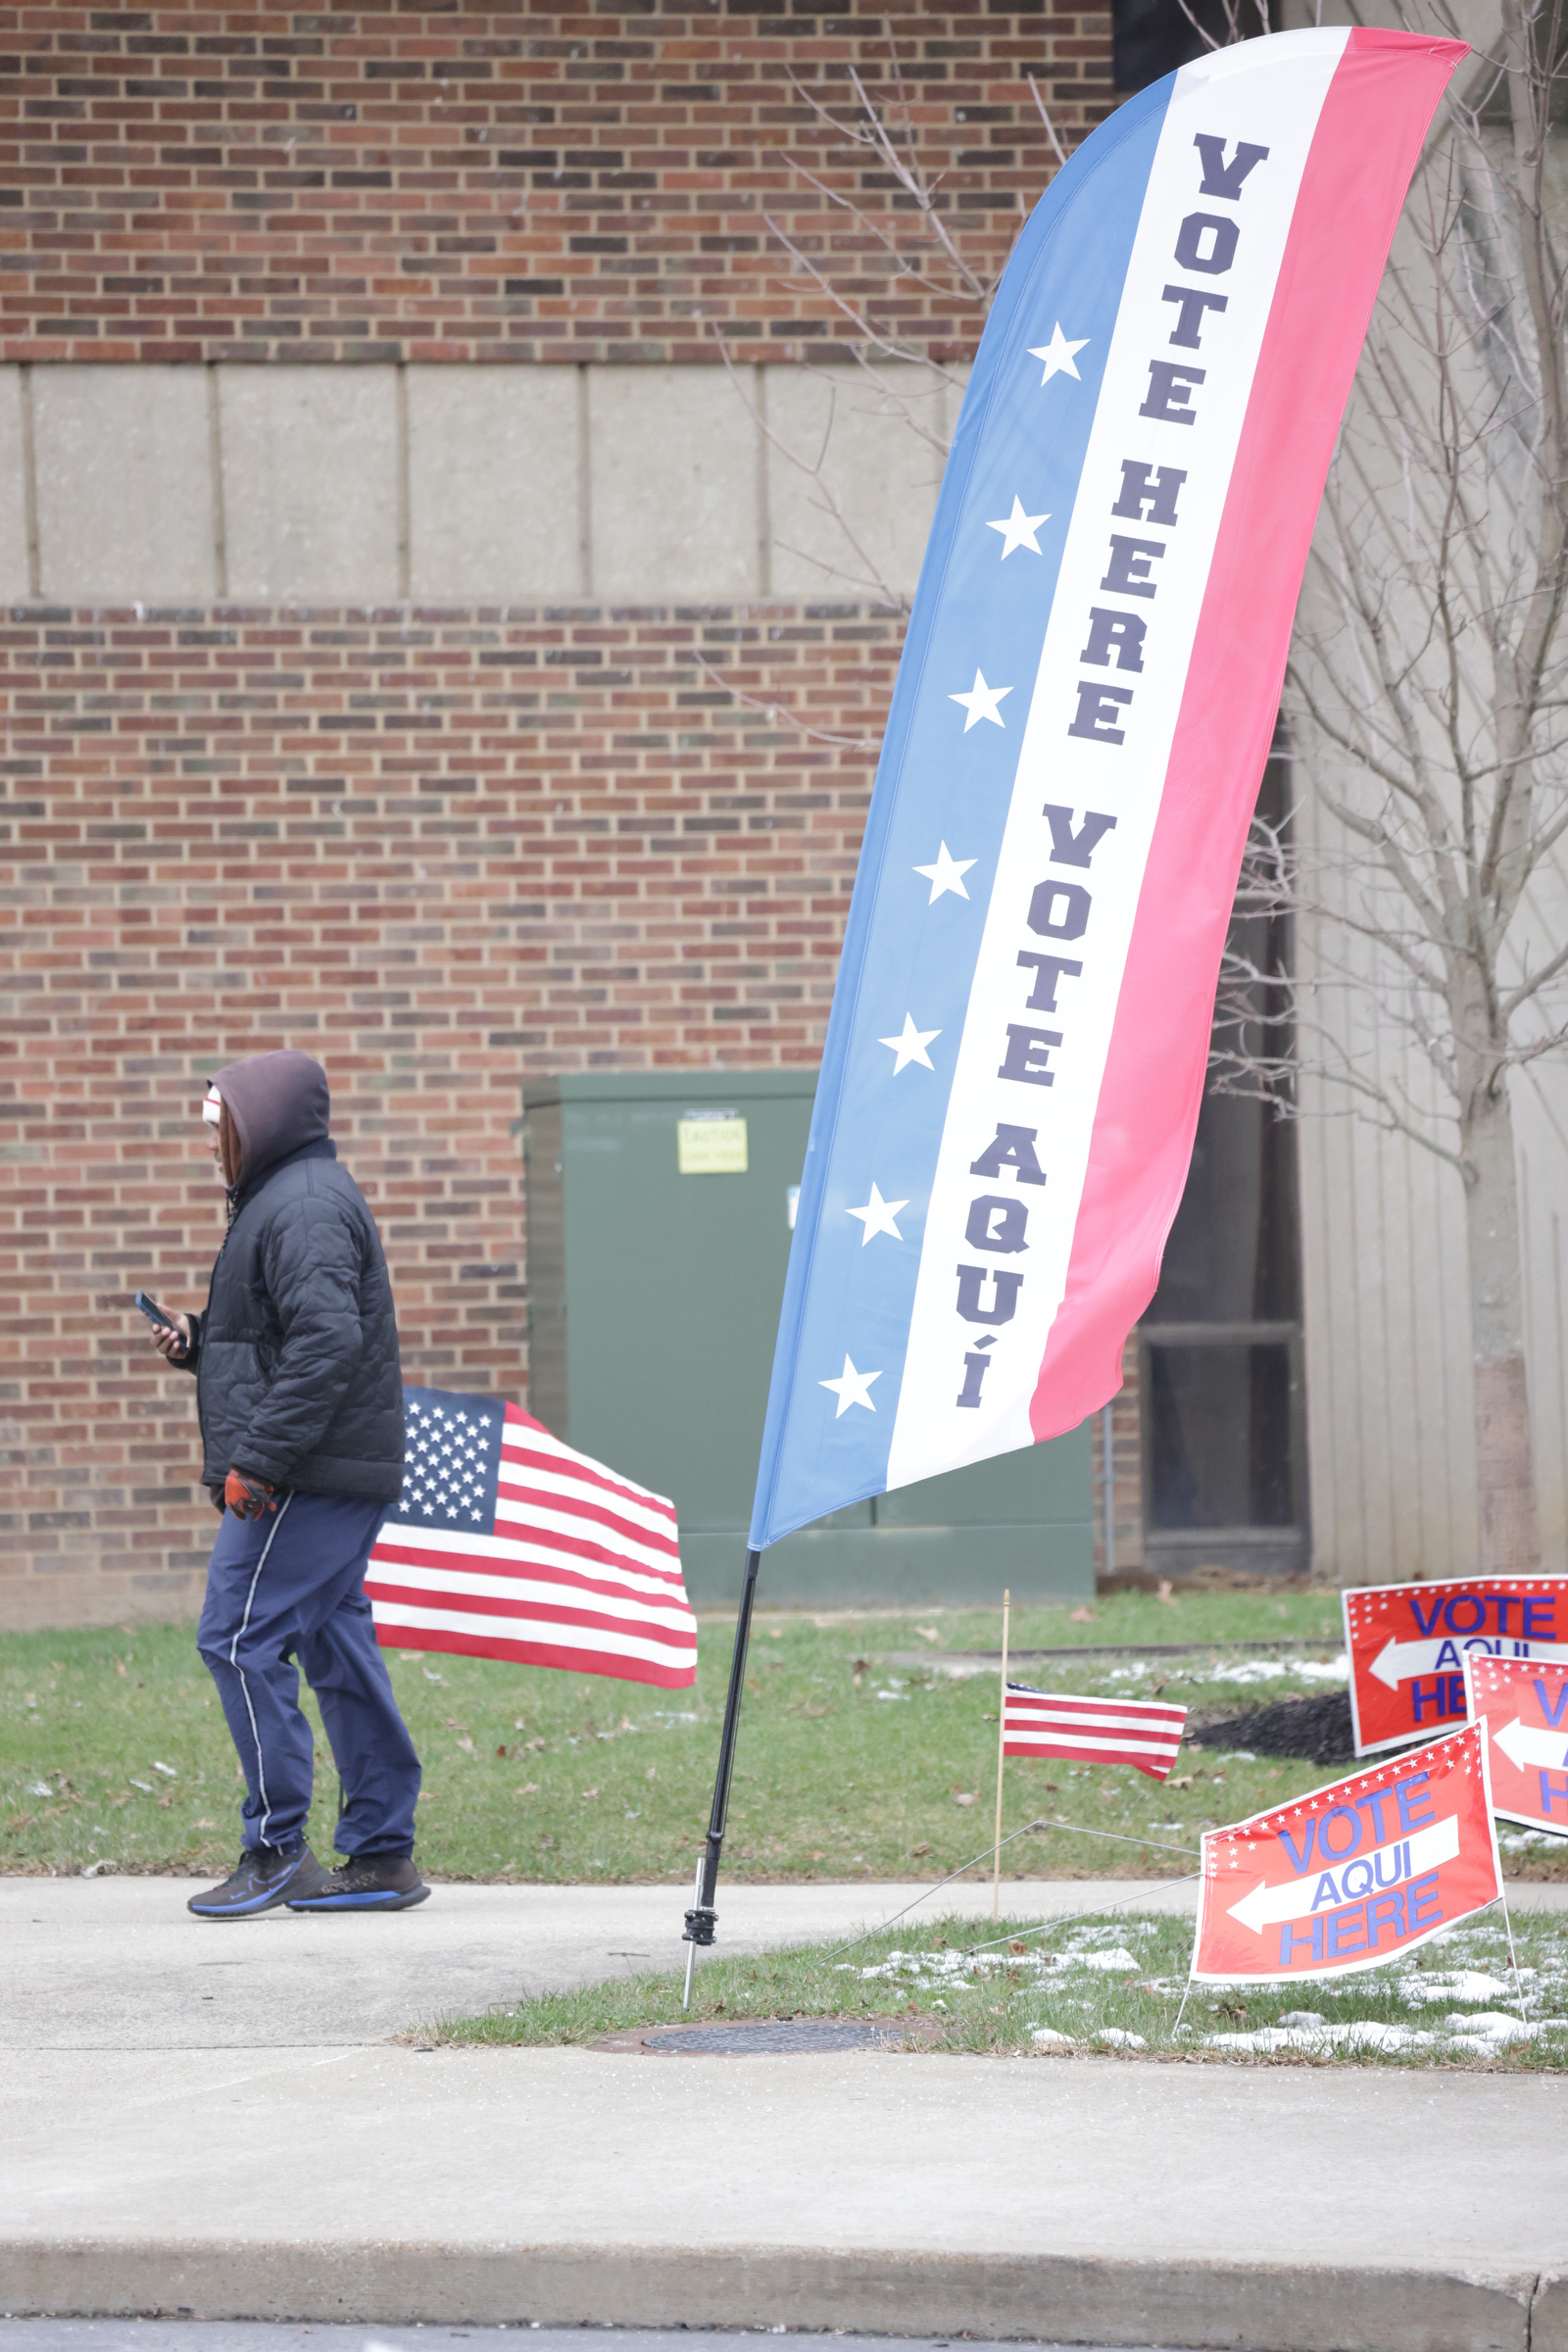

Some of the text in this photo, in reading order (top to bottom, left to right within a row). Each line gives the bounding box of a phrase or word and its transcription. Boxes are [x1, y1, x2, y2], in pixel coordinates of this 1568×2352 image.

[956, 132, 1271, 1409] VOTE HERE VOTE AQUÍ
[1409, 1594, 1556, 1640] VOTE
[1412, 1674, 1468, 1722] HE
[1278, 1772, 1436, 1875] VOTE
[1310, 1840, 1411, 1912] AQUI
[1279, 1872, 1443, 1966] HERE
